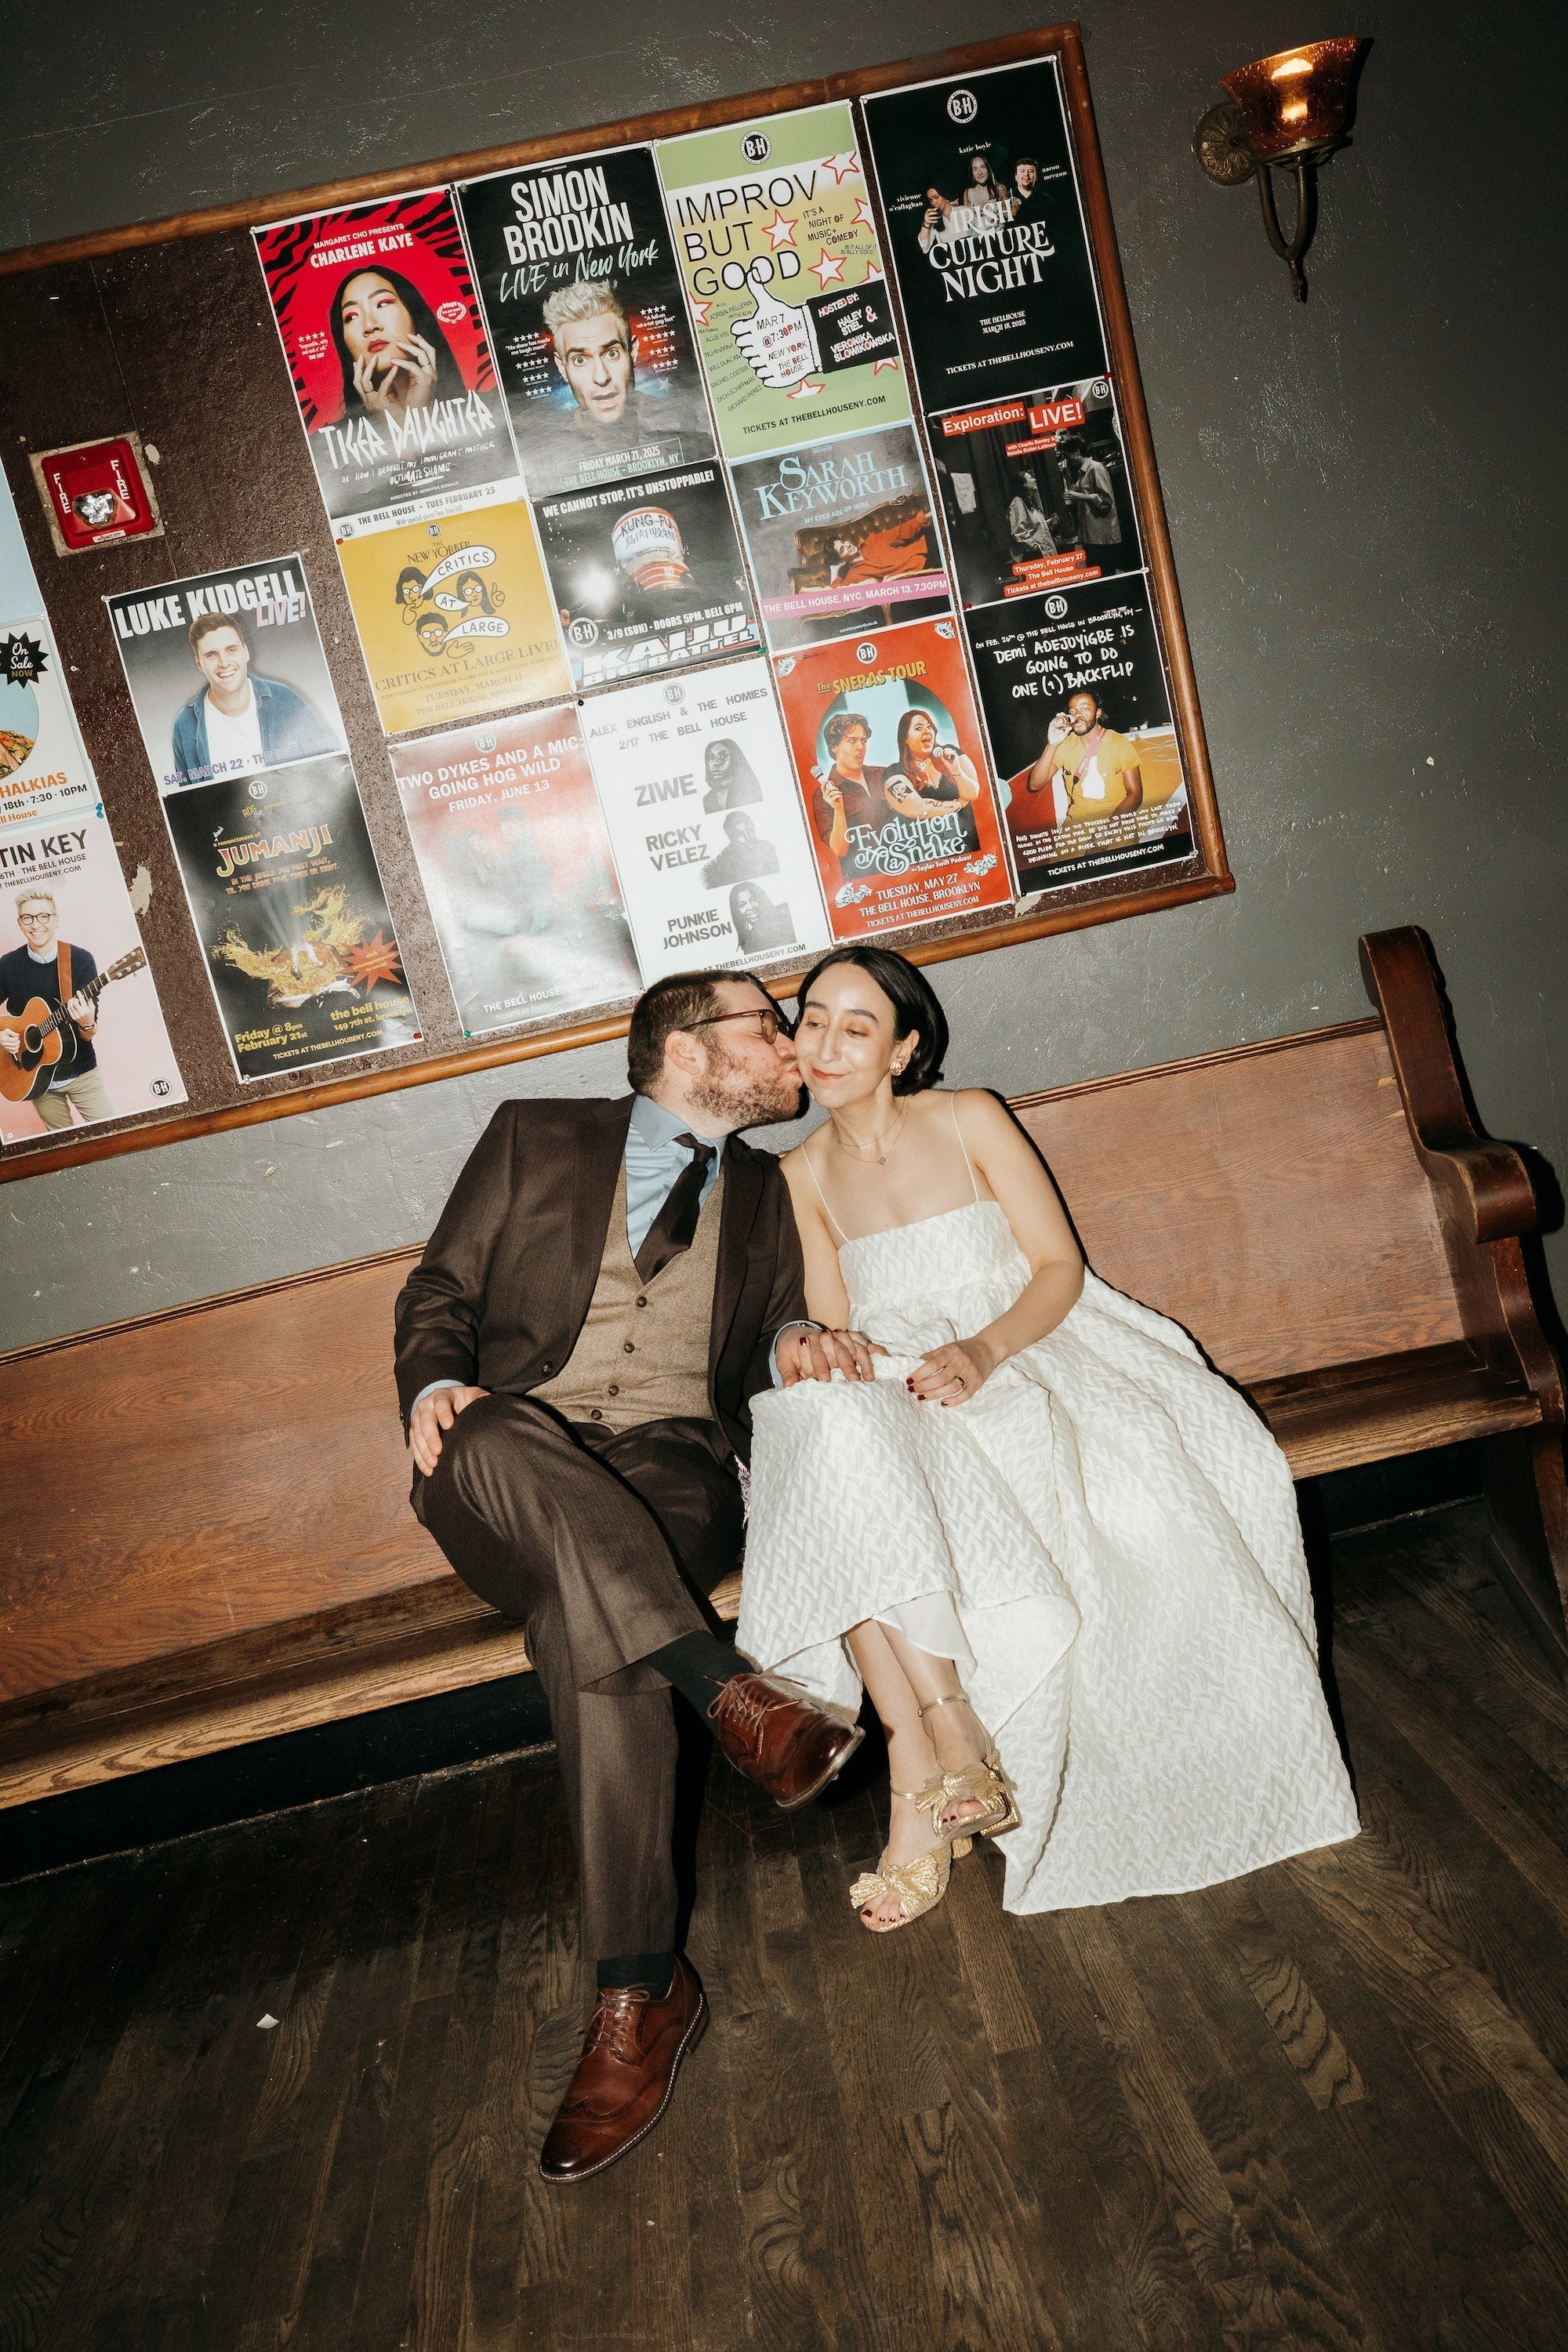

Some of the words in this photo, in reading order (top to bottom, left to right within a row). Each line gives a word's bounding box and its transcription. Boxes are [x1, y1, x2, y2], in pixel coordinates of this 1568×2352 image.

[959, 145, 975, 154] katie
[1042, 164, 1060, 172] aaron
[510, 166, 610, 222] SIMON
[676, 170, 817, 227] IMPROV
[897, 193, 922, 202] vivienne
[803, 208, 817, 219] IT'S
[808, 216, 833, 228] NIGHT
[833, 214, 844, 223] OF
[951, 199, 1014, 235] IRISH
[314, 234, 350, 249] MARGARET
[368, 223, 405, 236] PRESENTS
[503, 202, 634, 265] BRODKIN
[683, 221, 753, 263] BUT
[826, 229, 859, 245] COMEDY
[928, 221, 1055, 269] CULTURE
[310, 241, 376, 268] CHARLENE
[377, 234, 413, 252] KAYE
[499, 262, 550, 303] LIVE
[554, 262, 568, 278] in
[575, 250, 614, 283] New
[618, 239, 659, 276] York
[693, 250, 801, 296] GOOD
[941, 252, 1044, 302] NIGHT
[818, 298, 847, 318] HOSTED
[847, 292, 859, 304] BY:
[837, 309, 862, 328] HALEY
[866, 306, 877, 322] &
[757, 318, 778, 331] MAR
[779, 314, 786, 325] 7
[762, 321, 803, 347] @7:30PM
[841, 321, 863, 336] STIEL
[830, 332, 873, 354] VERONIKA
[833, 332, 895, 362] SLOWIKOWSKA
[946, 361, 977, 375] TICKETS
[988, 340, 1074, 365] THEBELLHOUSENY.COM
[742, 421, 776, 434] TICKETS
[791, 395, 886, 423] THEBELLHOUSENY.COM
[942, 407, 1025, 434] Exploration:
[1029, 399, 1083, 430] LIVE!
[318, 416, 389, 469] TIGER
[384, 390, 495, 458] DAUGHTER
[579, 457, 604, 472] FRIDAY
[605, 452, 630, 467] MARCH
[631, 448, 643, 462] 21,
[643, 446, 660, 459] 2025
[53, 472, 71, 514] FIRE
[111, 459, 130, 500] FIRE
[543, 506, 558, 517] WE
[560, 495, 599, 514] CANNOT
[601, 490, 626, 506] STOP,
[626, 485, 644, 500] IT'S
[645, 470, 715, 495] UNSTOPPABLE!
[426, 499, 443, 509] TUES
[446, 491, 482, 504] FEBRUARY
[485, 487, 495, 495] 25
[374, 512, 390, 521] BELL
[393, 505, 416, 517] HOUSE
[438, 551, 489, 575] CRITICS
[1014, 561, 1046, 573] Thursday,
[1047, 556, 1074, 568] February
[1028, 572, 1040, 580] The
[1054, 565, 1073, 575] House
[1006, 584, 1029, 594] Tickets
[1037, 569, 1098, 588] thebellhouseny.com
[114, 596, 187, 639] LUKE
[186, 570, 301, 621] KIDGELL
[256, 592, 307, 627] LIVE!
[441, 597, 456, 608] AT
[764, 604, 782, 614] THE
[784, 600, 807, 611] BELL
[866, 586, 898, 599] MARCH
[914, 579, 947, 593] 7.30PM
[463, 621, 503, 633] LARGE
[607, 628, 623, 640] 3/9
[653, 615, 682, 630] DOORS
[684, 611, 705, 623] 5PM,
[705, 606, 724, 619] BELL
[724, 602, 743, 615] 6PM
[1121, 624, 1135, 637] IS
[13, 641, 29, 656] On
[583, 615, 747, 677] KAIJU
[648, 630, 755, 666] BATTEL
[10, 656, 34, 670] Sale
[1026, 656, 1068, 674] GOING
[1074, 652, 1092, 665] TO
[1100, 648, 1118, 661] DO
[817, 682, 832, 691] The
[833, 670, 886, 695] SNERAS
[888, 661, 927, 681] TOUR
[1012, 682, 1038, 698] ONE
[1042, 674, 1064, 695] (1)
[1064, 661, 1134, 688] BACKFLIP
[590, 724, 618, 739] ALEX
[626, 710, 671, 730] ENGLISH
[681, 707, 689, 716] &
[697, 699, 717, 712] THE
[726, 688, 768, 706] HOMIES
[397, 771, 434, 791] TWO
[437, 757, 490, 782] DYKES
[495, 749, 528, 768] AND
[533, 746, 544, 757] A
[548, 736, 584, 755] MIC:
[429, 778, 479, 800] GOING
[483, 768, 517, 787] HOG
[521, 757, 561, 777] WILD
[633, 774, 697, 808] ZIWE
[31, 793, 53, 804] 7:30
[60, 784, 87, 797] 10PM
[41, 829, 86, 858] KEY
[645, 824, 702, 852] RICKY
[844, 811, 967, 851] Evolution
[21, 865, 36, 875] THE
[39, 860, 58, 870] BELL
[59, 854, 86, 866] HOUSE
[216, 824, 333, 877] JUMANJI
[650, 844, 710, 872] VELEZ
[917, 861, 935, 872] Taylor
[951, 855, 971, 865] Podcast
[876, 882, 924, 901] TUESDAY,
[924, 877, 945, 890] MAY
[946, 873, 958, 884] 27
[666, 909, 720, 932] PUNKIE
[663, 922, 733, 950] JOHNSON
[330, 1009, 350, 1021] the
[352, 1003, 372, 1016] bell
[375, 996, 409, 1010] house
[234, 1029, 270, 1044] Friday
[272, 1025, 283, 1036] @
[284, 1022, 303, 1032] 8pm
[237, 1035, 288, 1053] February
[290, 1031, 308, 1041] 21st
